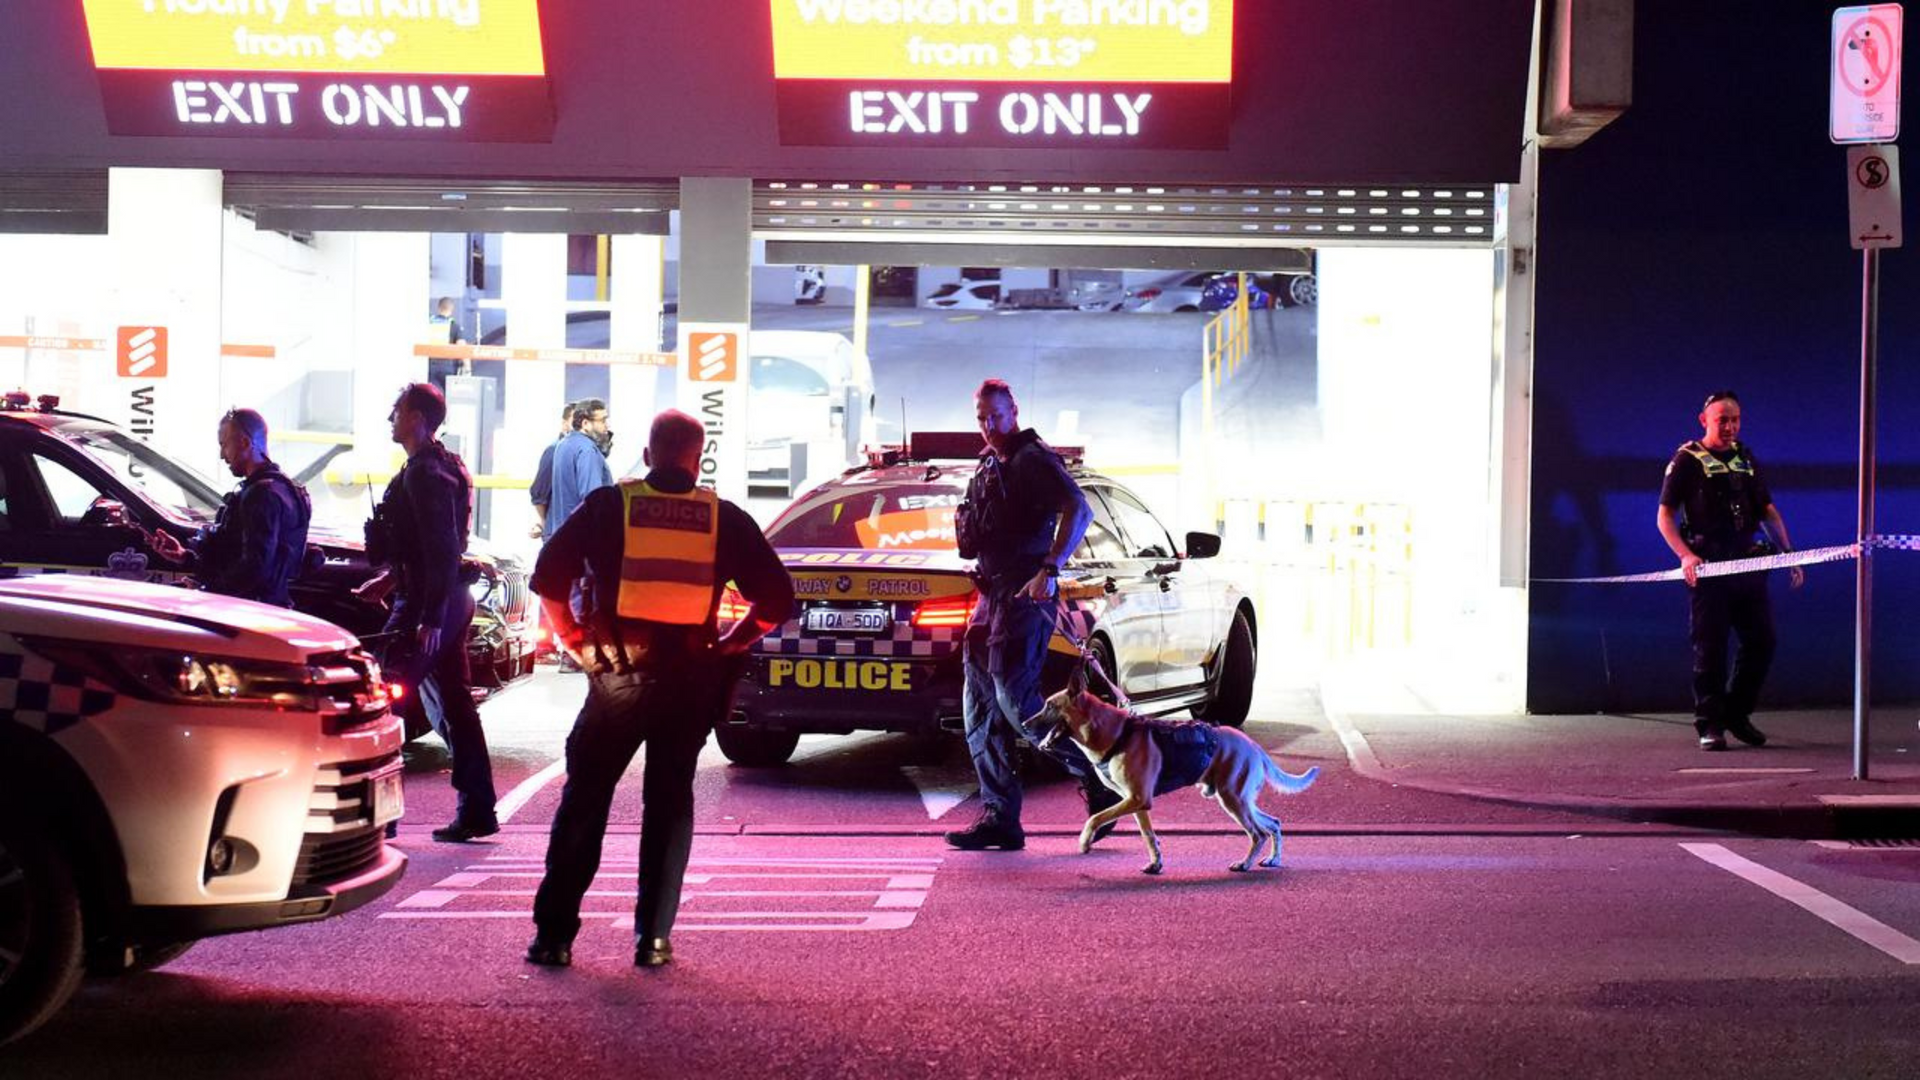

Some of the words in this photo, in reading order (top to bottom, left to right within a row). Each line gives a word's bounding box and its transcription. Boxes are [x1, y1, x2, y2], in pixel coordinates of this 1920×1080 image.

[795, 0, 1018, 25] Weekend
[1033, 0, 1210, 35] Parking
[234, 25, 327, 57] from
[905, 35, 998, 66] from
[172, 81, 299, 124] EXIT
[321, 84, 470, 127] ONLY
[850, 91, 979, 133] EXIT
[999, 92, 1152, 135] ONLY
[632, 497, 708, 523] Police
[778, 551, 930, 567] POLIC
[867, 578, 930, 595] PATROL
[769, 659, 912, 690] POLICE
